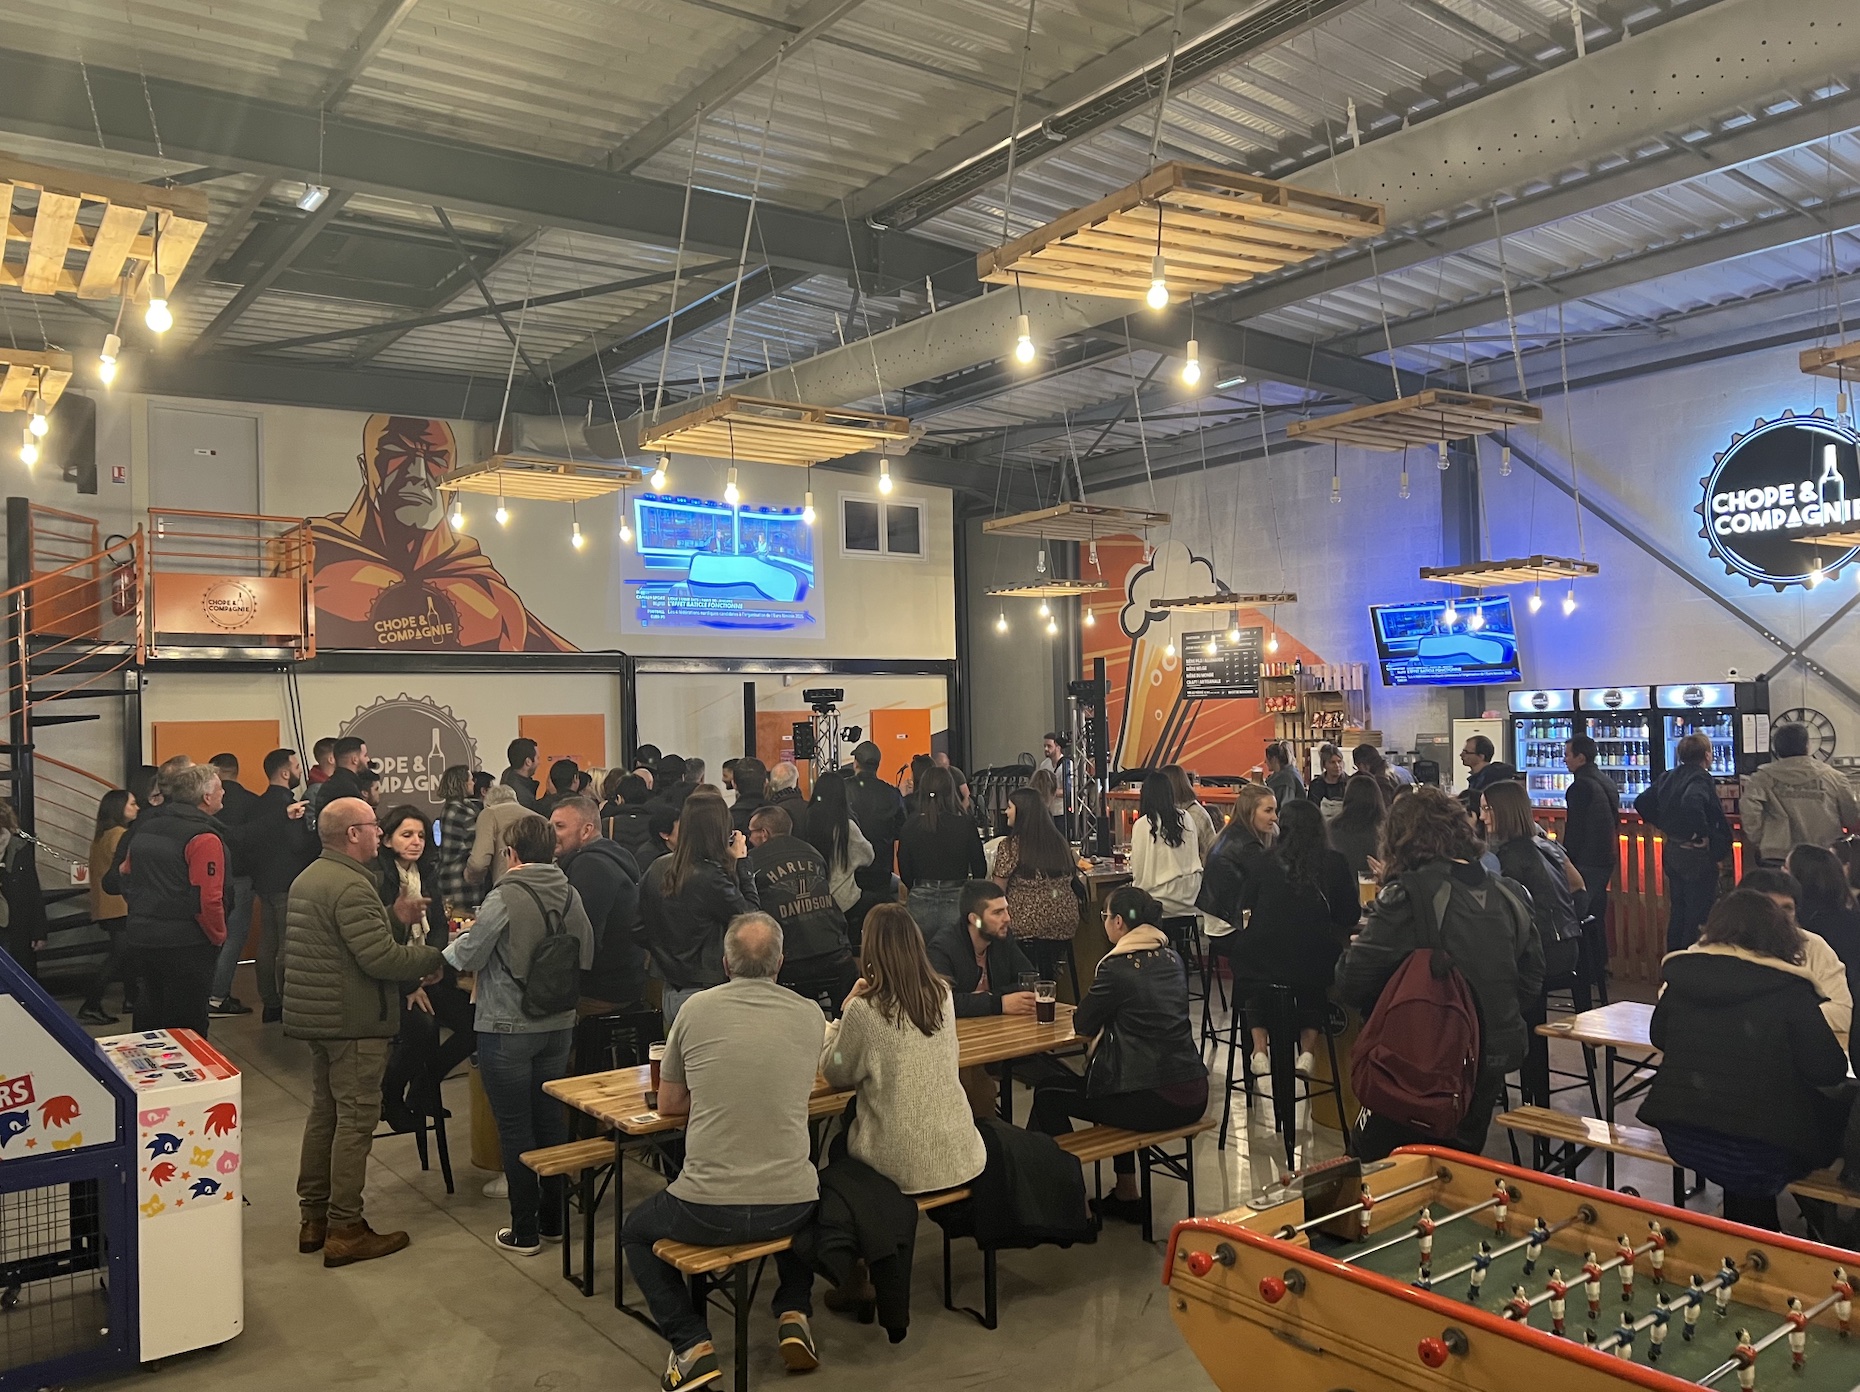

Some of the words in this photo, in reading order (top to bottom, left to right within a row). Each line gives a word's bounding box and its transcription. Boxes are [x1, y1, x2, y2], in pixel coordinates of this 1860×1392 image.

[1712, 483, 1796, 514] CHOPE
[1799, 481, 1819, 503] &
[374, 616, 417, 632] CHOPE
[419, 615, 427, 626] &
[377, 623, 453, 644] COMPAGNIE
[369, 756, 409, 774] OPE
[412, 755, 426, 773] &
[379, 774, 443, 794] MPAGN
[207, 861, 216, 877] 6
[766, 860, 821, 884] HARLEY
[779, 894, 833, 919] DAVIDSON
